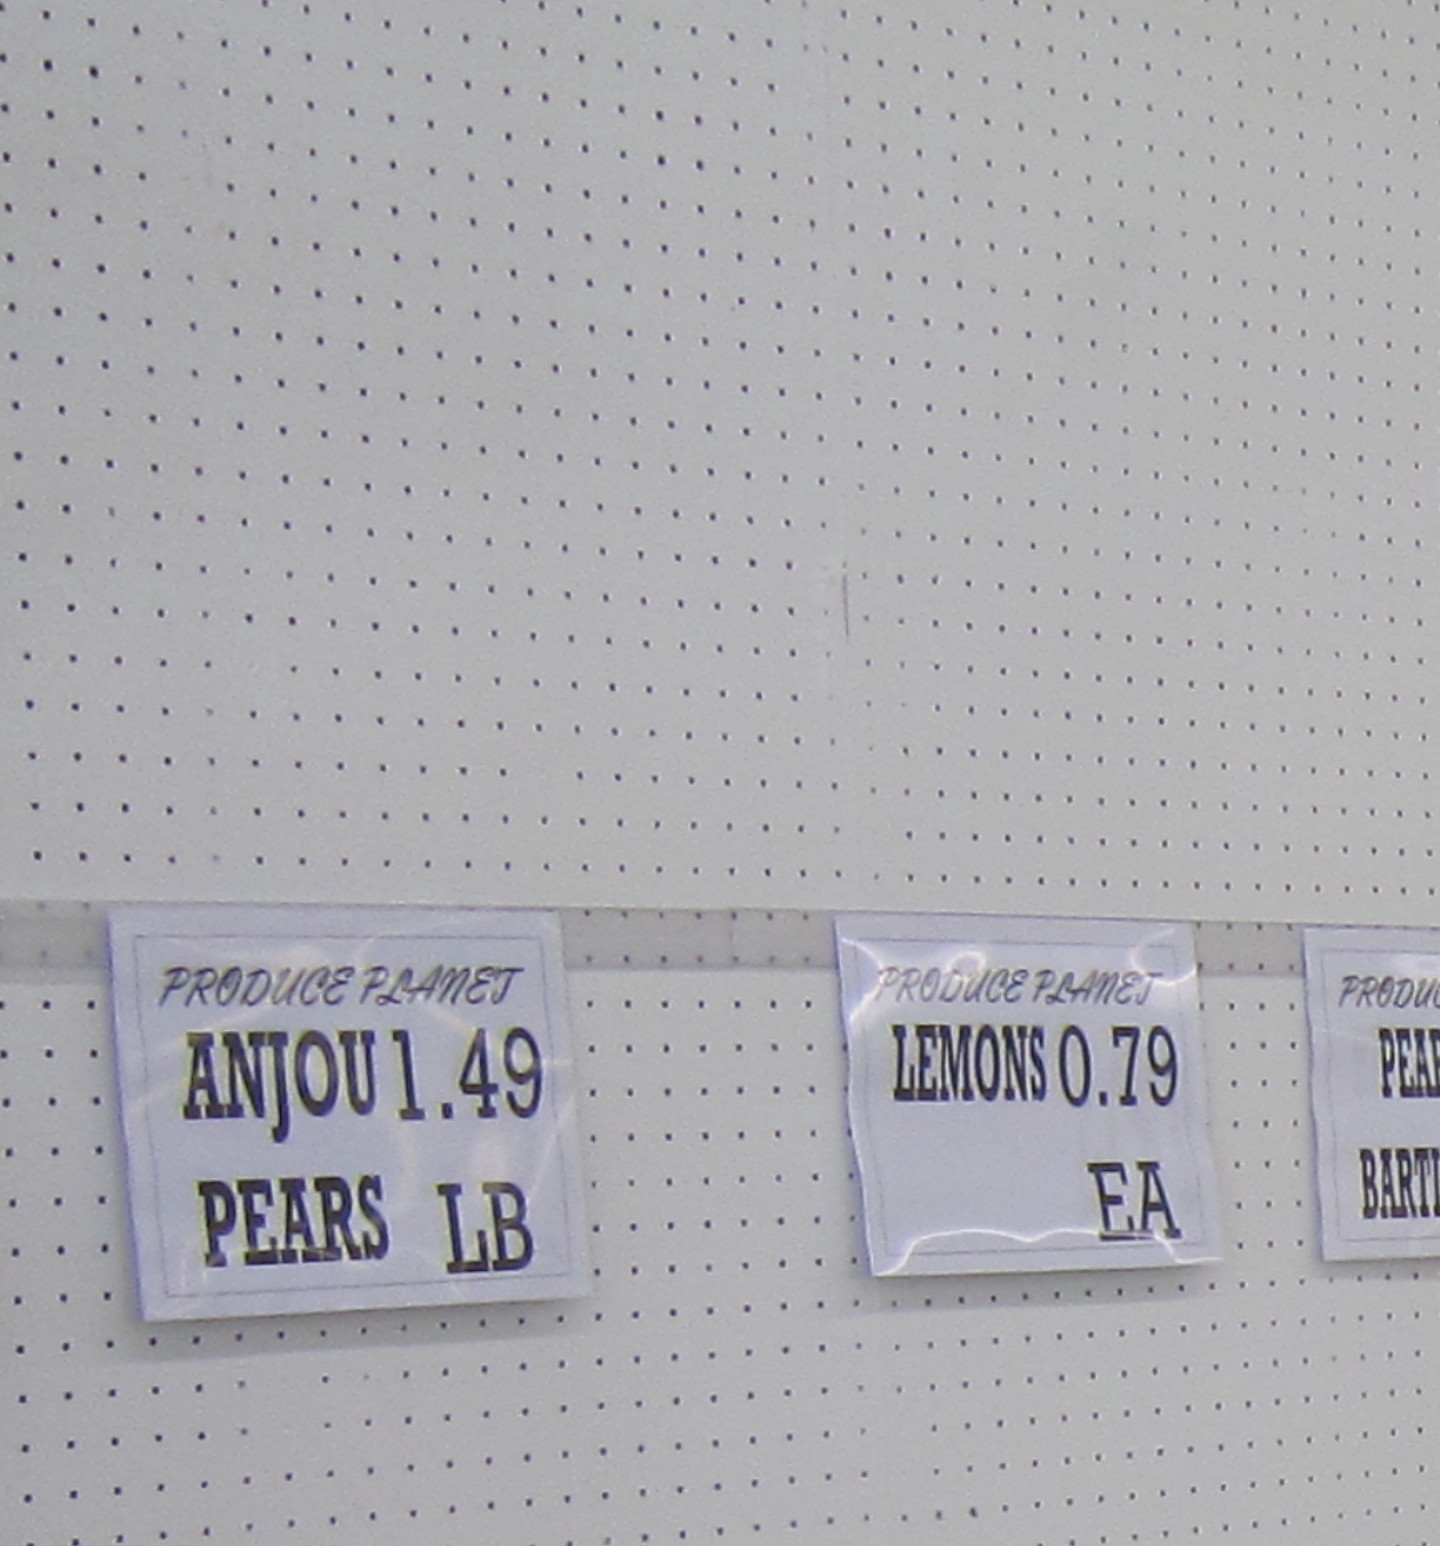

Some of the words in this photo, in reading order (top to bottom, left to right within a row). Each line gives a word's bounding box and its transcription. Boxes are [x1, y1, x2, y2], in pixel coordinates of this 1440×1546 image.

[157, 967, 356, 1008] PRODUCE
[359, 966, 526, 1006] PLANET
[874, 966, 1031, 1004] PRODUCE
[1034, 971, 1164, 1006] PLANET
[183, 1029, 376, 1143] ANJOU
[393, 1026, 543, 1120] 1.49
[891, 1023, 1047, 1102] LEMONS
[1058, 1024, 1178, 1107] 0.79
[197, 1174, 389, 1267] PEARS
[437, 1182, 534, 1273] LB
[1088, 1161, 1181, 1241] EA
